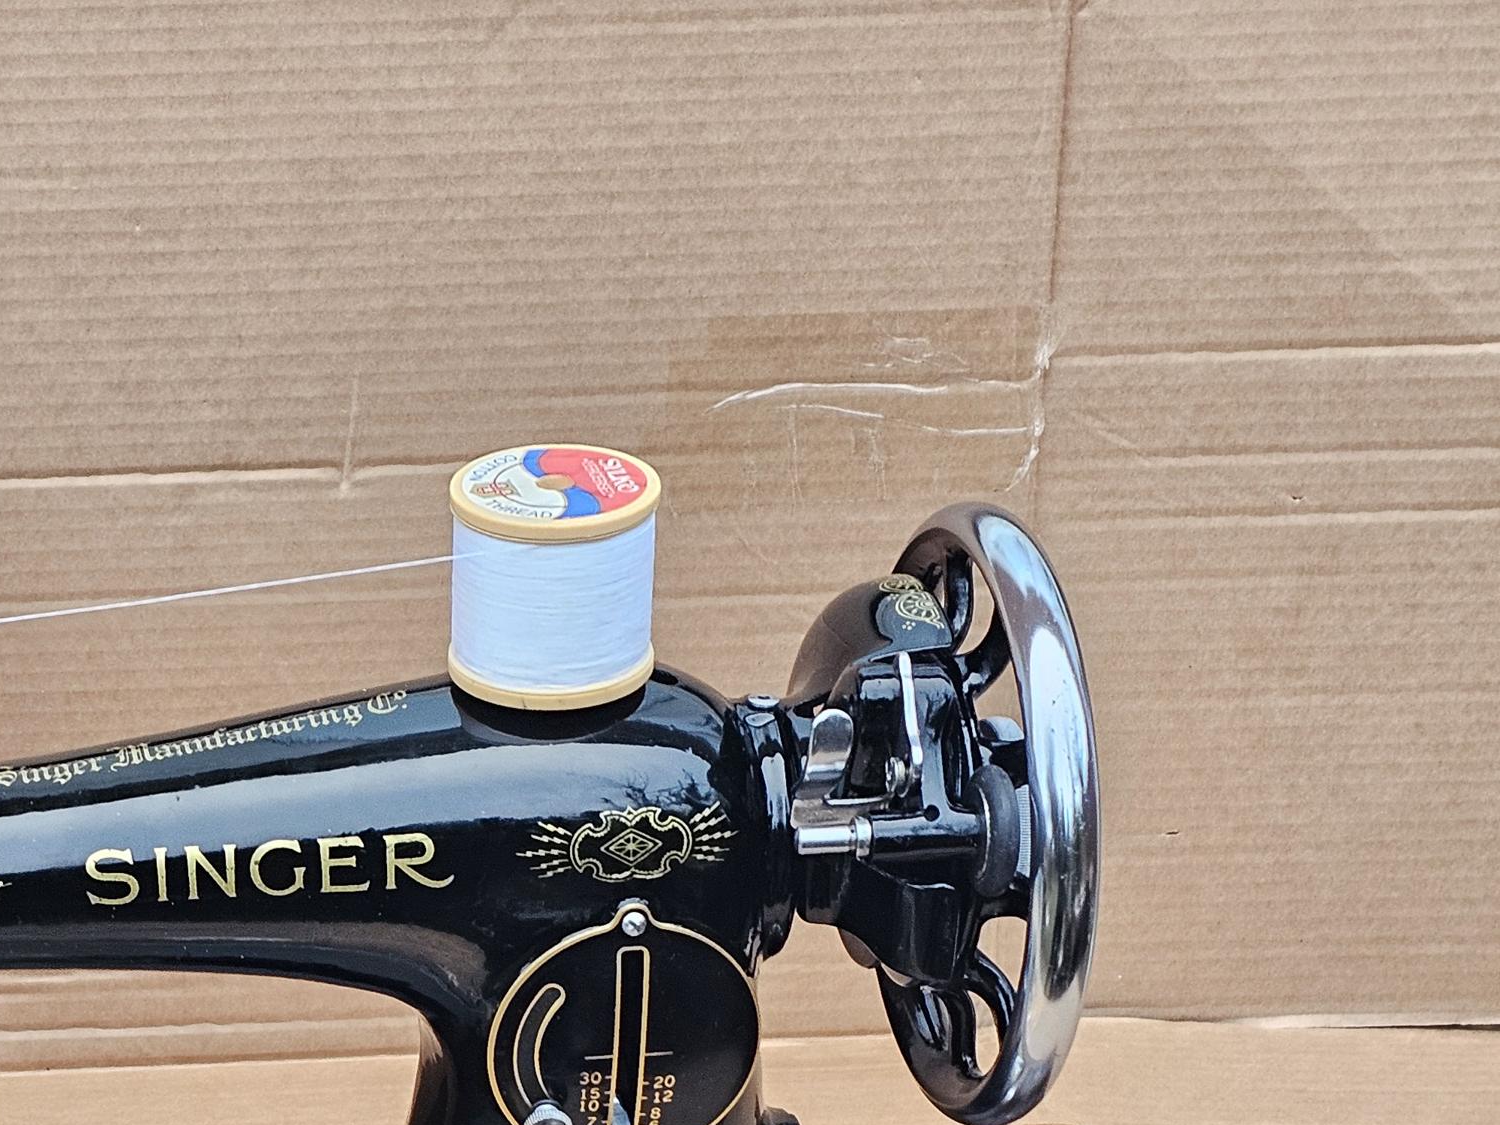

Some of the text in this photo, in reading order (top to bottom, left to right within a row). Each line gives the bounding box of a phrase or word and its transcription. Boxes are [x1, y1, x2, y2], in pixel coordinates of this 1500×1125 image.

[485, 499, 553, 519] THREAD
[107, 704, 363, 773] Manufacturing
[85, 832, 455, 905] SINGER
[579, 1072, 601, 1085] 30
[653, 1075, 676, 1088] 20
[581, 1088, 600, 1100] 15
[653, 1090, 673, 1103] 12
[580, 1101, 599, 1112] 10
[650, 1107, 661, 1119] 8
